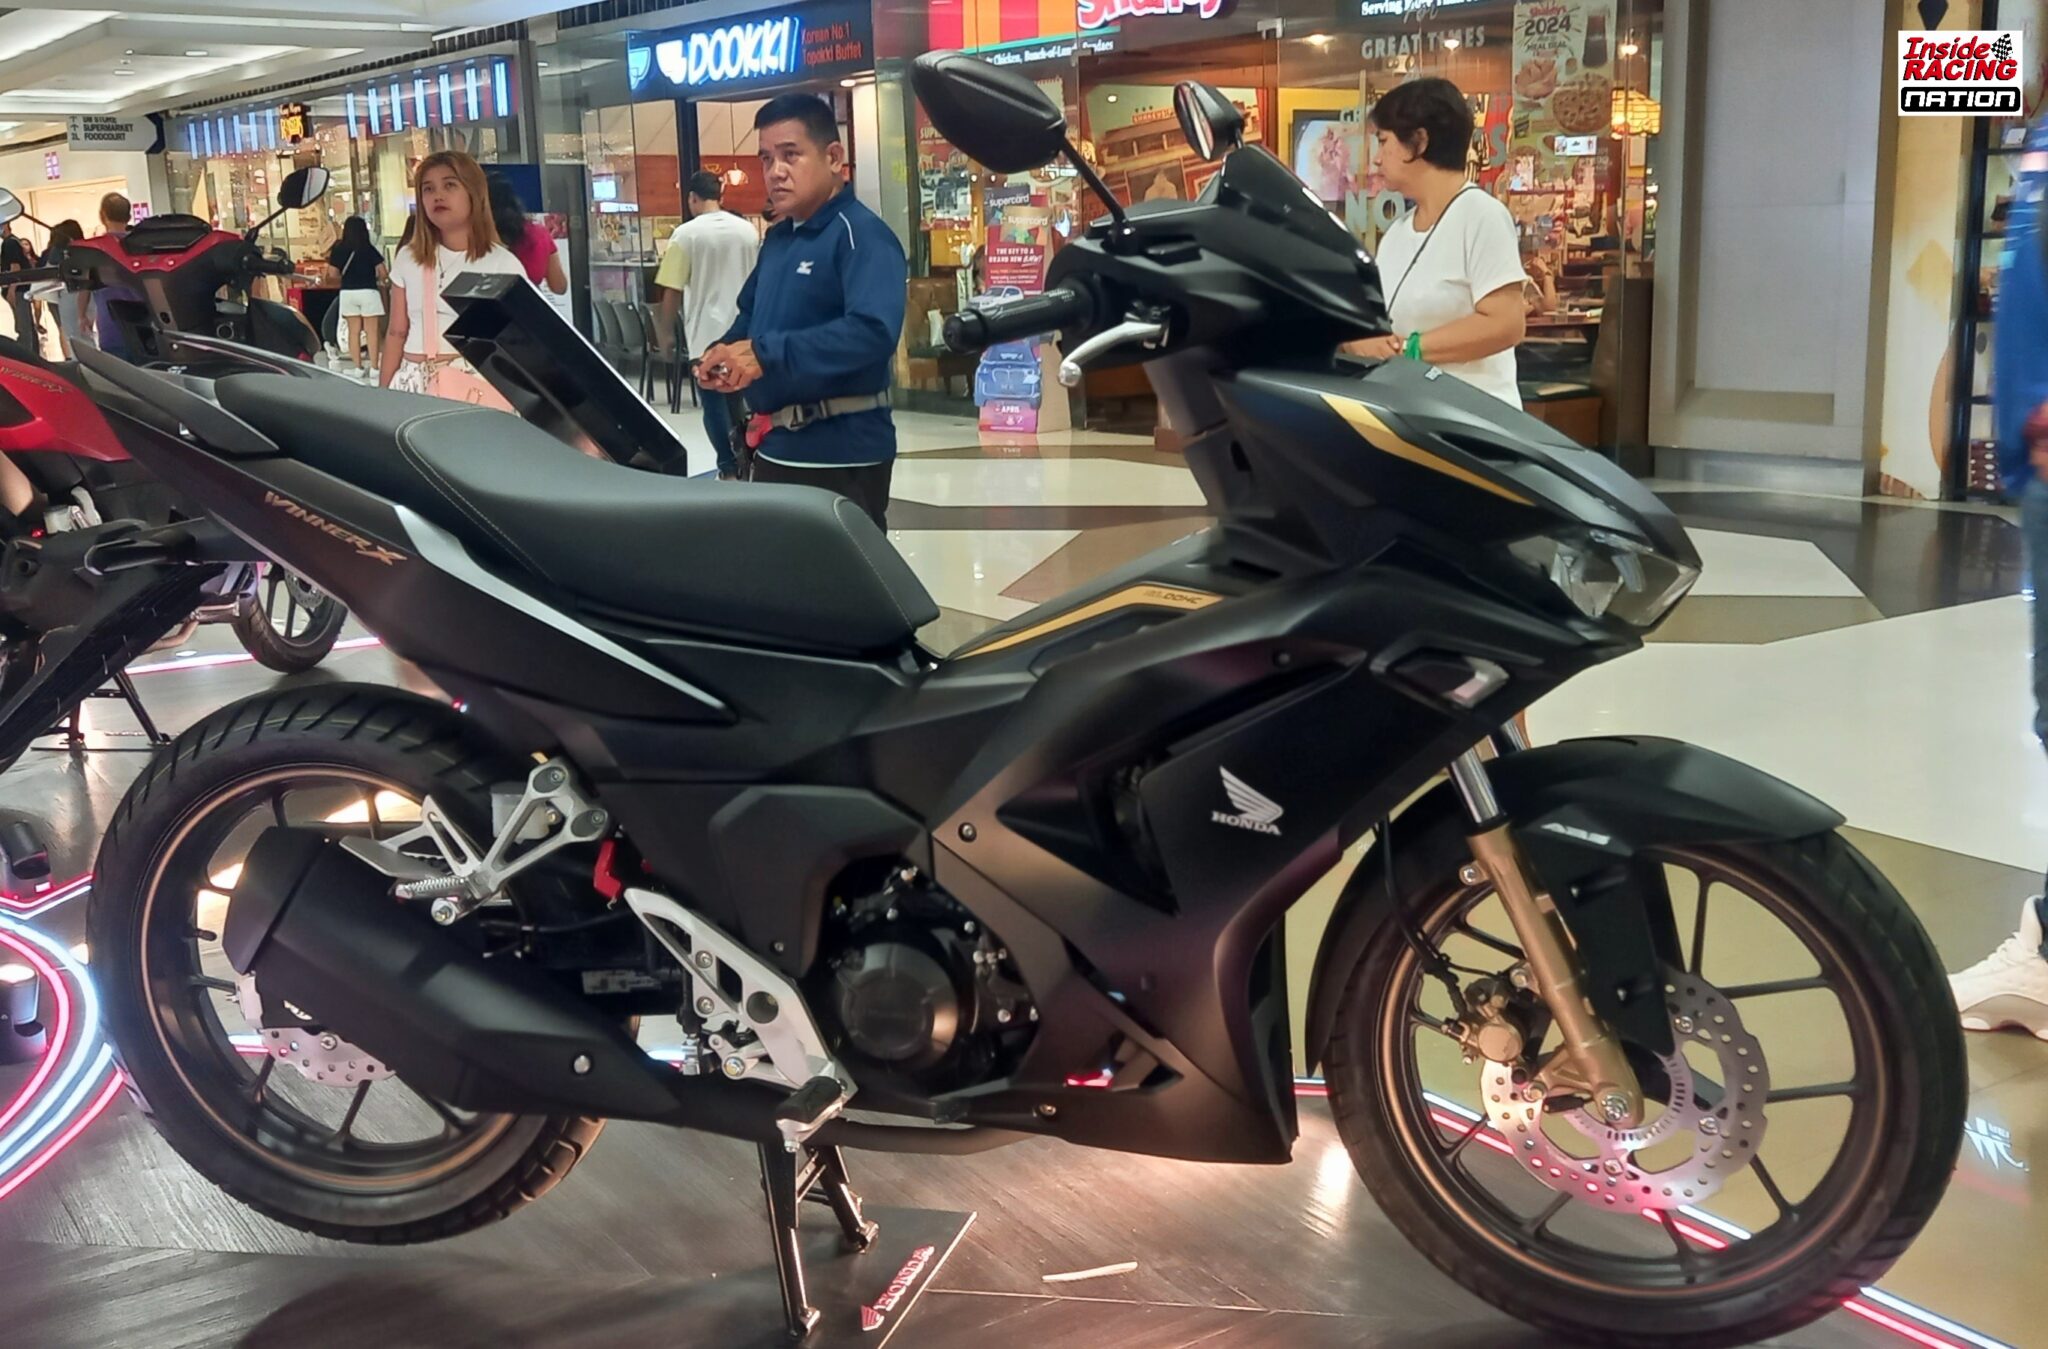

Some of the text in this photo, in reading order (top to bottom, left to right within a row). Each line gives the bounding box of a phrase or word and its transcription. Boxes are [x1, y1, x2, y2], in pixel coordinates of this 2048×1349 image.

[1361, 1, 1403, 16] Serving
[1524, 15, 1572, 37] 2024
[687, 16, 799, 86] DOOKKI
[1361, 33, 1420, 60] GREAT
[83, 123, 134, 133] SUPERMARKET
[1211, 810, 1282, 836] HONDA
